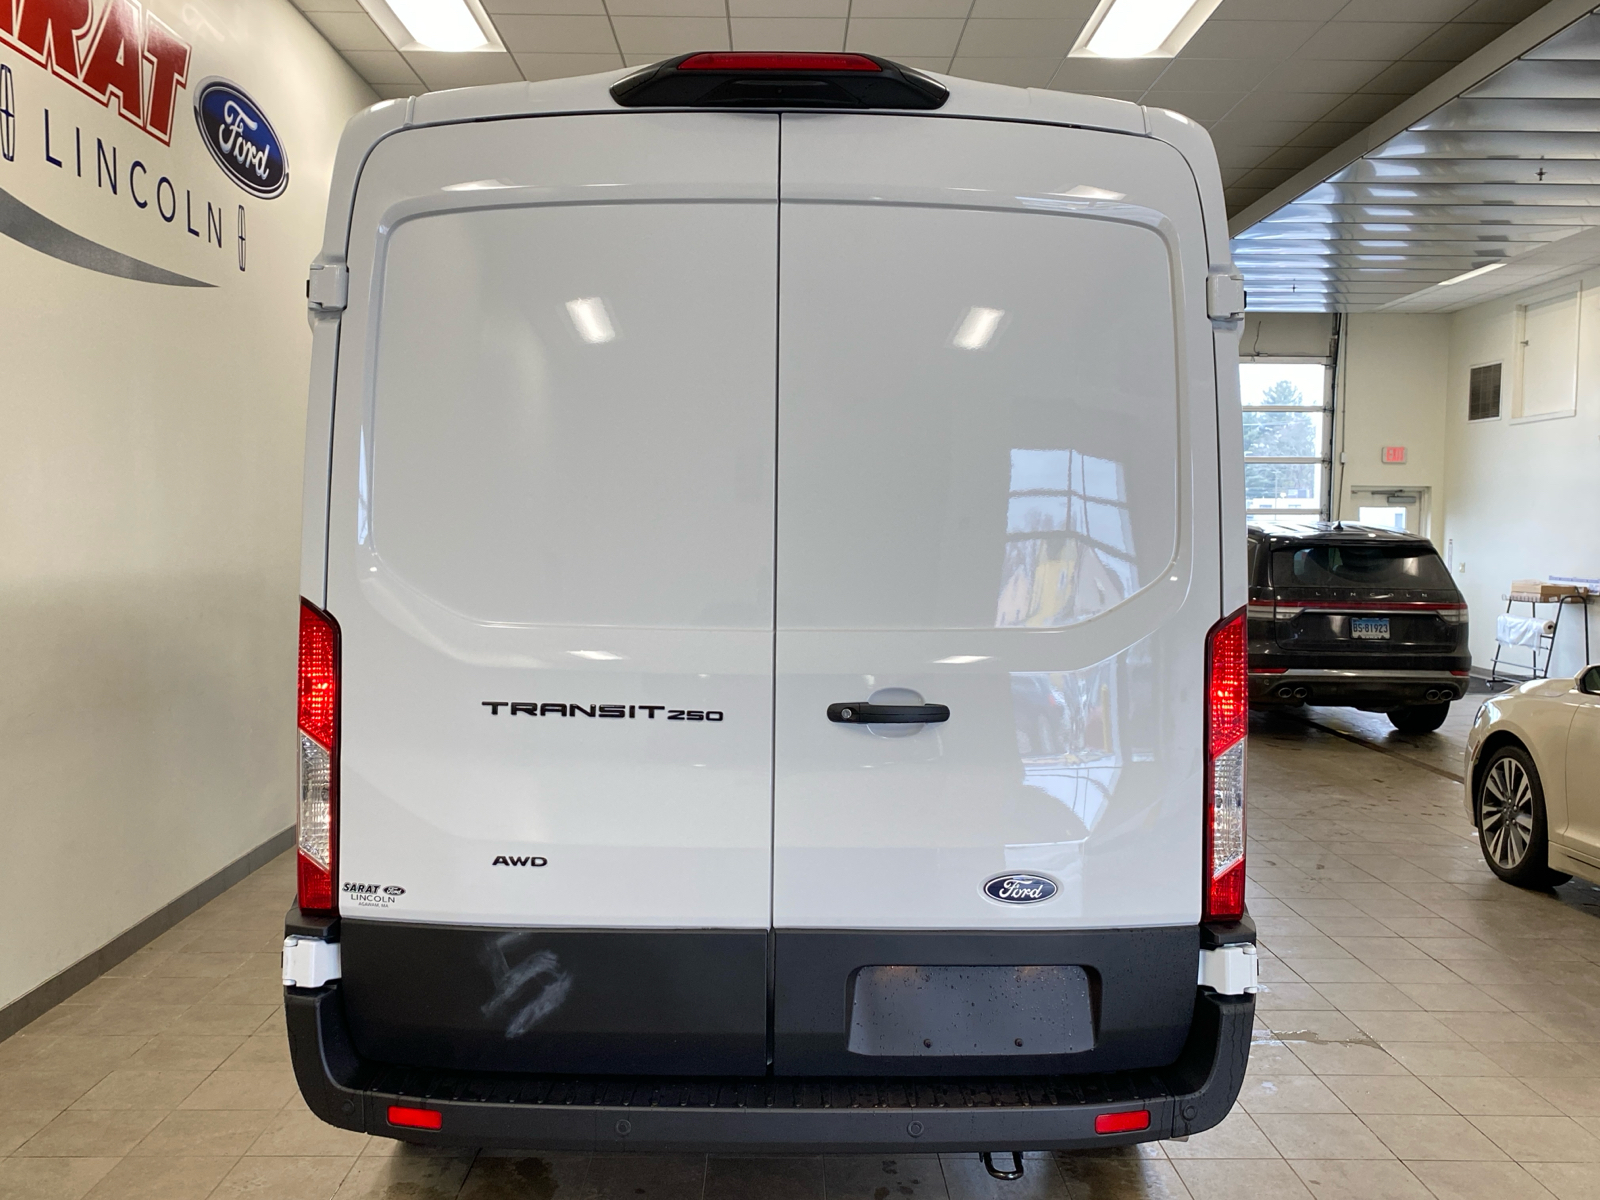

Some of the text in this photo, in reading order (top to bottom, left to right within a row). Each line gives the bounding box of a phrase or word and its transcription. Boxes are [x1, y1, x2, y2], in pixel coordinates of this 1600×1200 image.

[218, 100, 270, 181] Ford
[44, 108, 222, 248] LINCOLN
[1386, 446, 1404, 461] EXIT
[1315, 591, 1428, 599] LINCOLN
[482, 701, 724, 722] TRANSIT 250
[492, 855, 548, 867] AWD
[342, 882, 380, 894] SARAT
[999, 879, 1043, 899] Ford
[350, 894, 396, 903] LINCOLN
